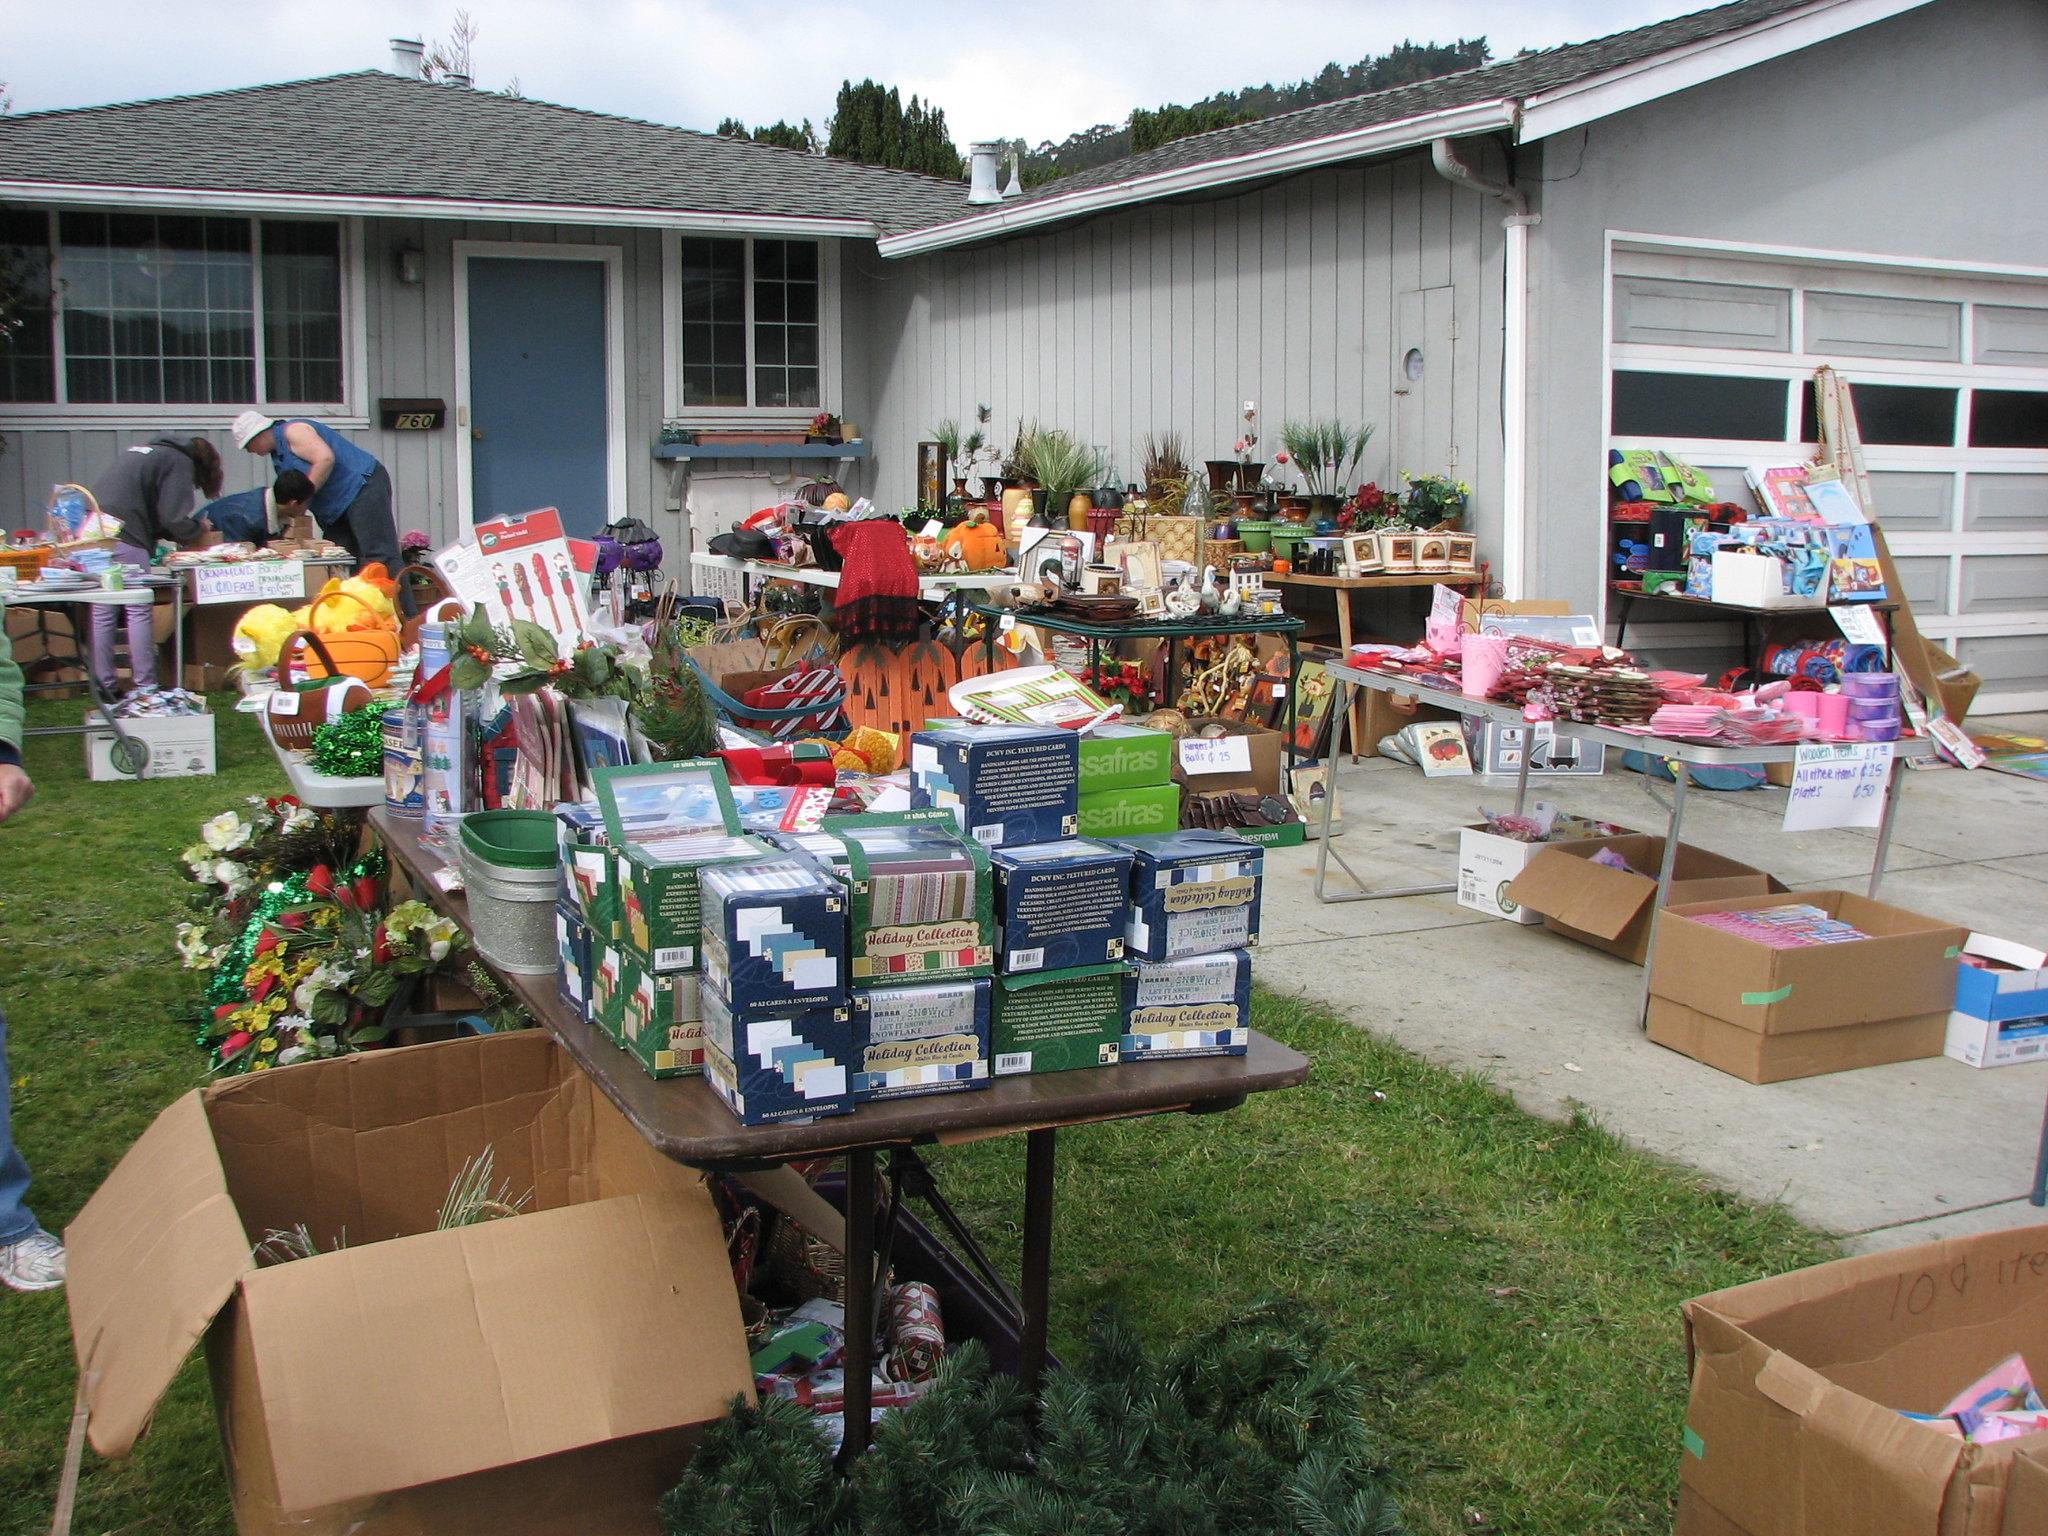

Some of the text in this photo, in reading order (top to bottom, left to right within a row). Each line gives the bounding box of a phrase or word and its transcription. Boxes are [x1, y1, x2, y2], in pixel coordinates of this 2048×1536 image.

[398, 415, 432, 428] 760
[1185, 752, 1205, 762] Balls
[1800, 747, 1831, 760] Wooden
[1796, 769, 1808, 782] All
[1066, 869, 1096, 878] TEXTURED
[1170, 890, 1216, 905] Collection
[868, 928, 974, 948] Holiday Collection
[794, 996, 828, 1004] ENVELOPES
[1140, 994, 1190, 1002] SNOWFLAKE
[1134, 1008, 1232, 1026] Holiday Collection
[672, 1028, 702, 1040] Holid
[871, 1028, 922, 1038] SNOWFLAKE
[868, 1042, 972, 1062] Holiday Collection
[804, 1103, 839, 1113] ENVELOPES
